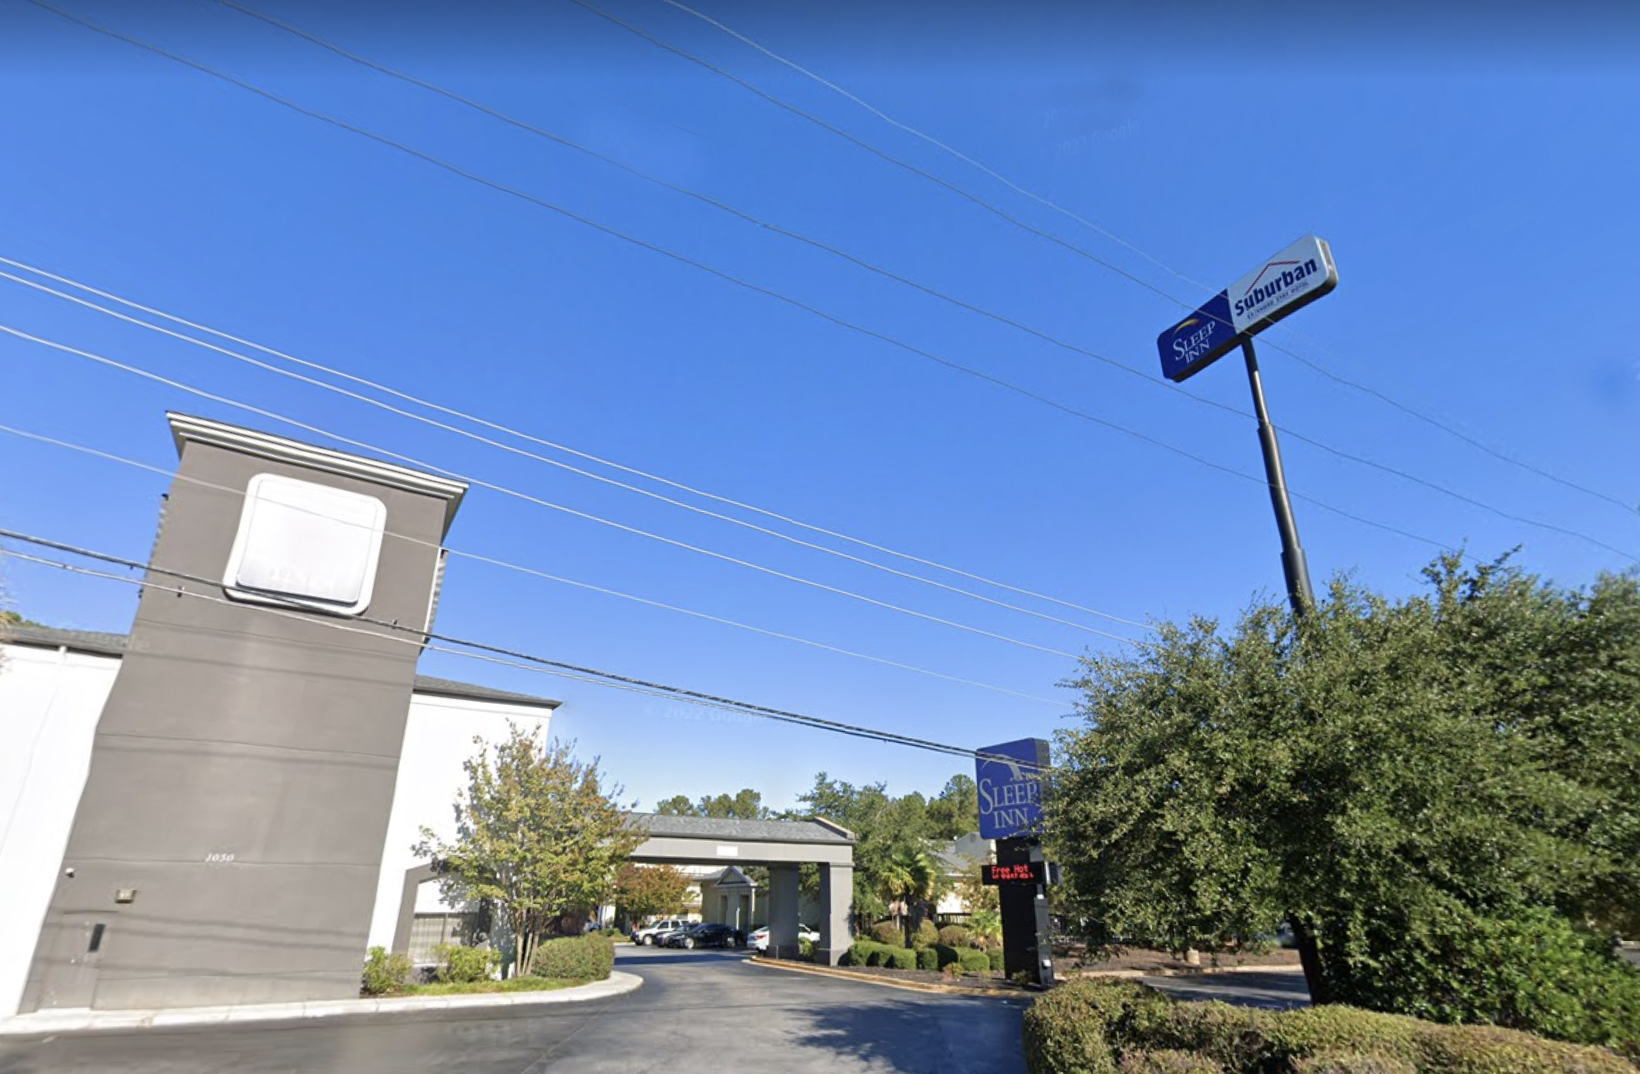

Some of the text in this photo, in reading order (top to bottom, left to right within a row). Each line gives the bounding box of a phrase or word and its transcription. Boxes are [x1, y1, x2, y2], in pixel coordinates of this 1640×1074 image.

[1172, 320, 1216, 361] SLEEP
[1185, 339, 1211, 364] INN
[979, 778, 1038, 815] SLEEP
[993, 807, 1029, 830] INN
[992, 864, 1029, 874] Free Hot
